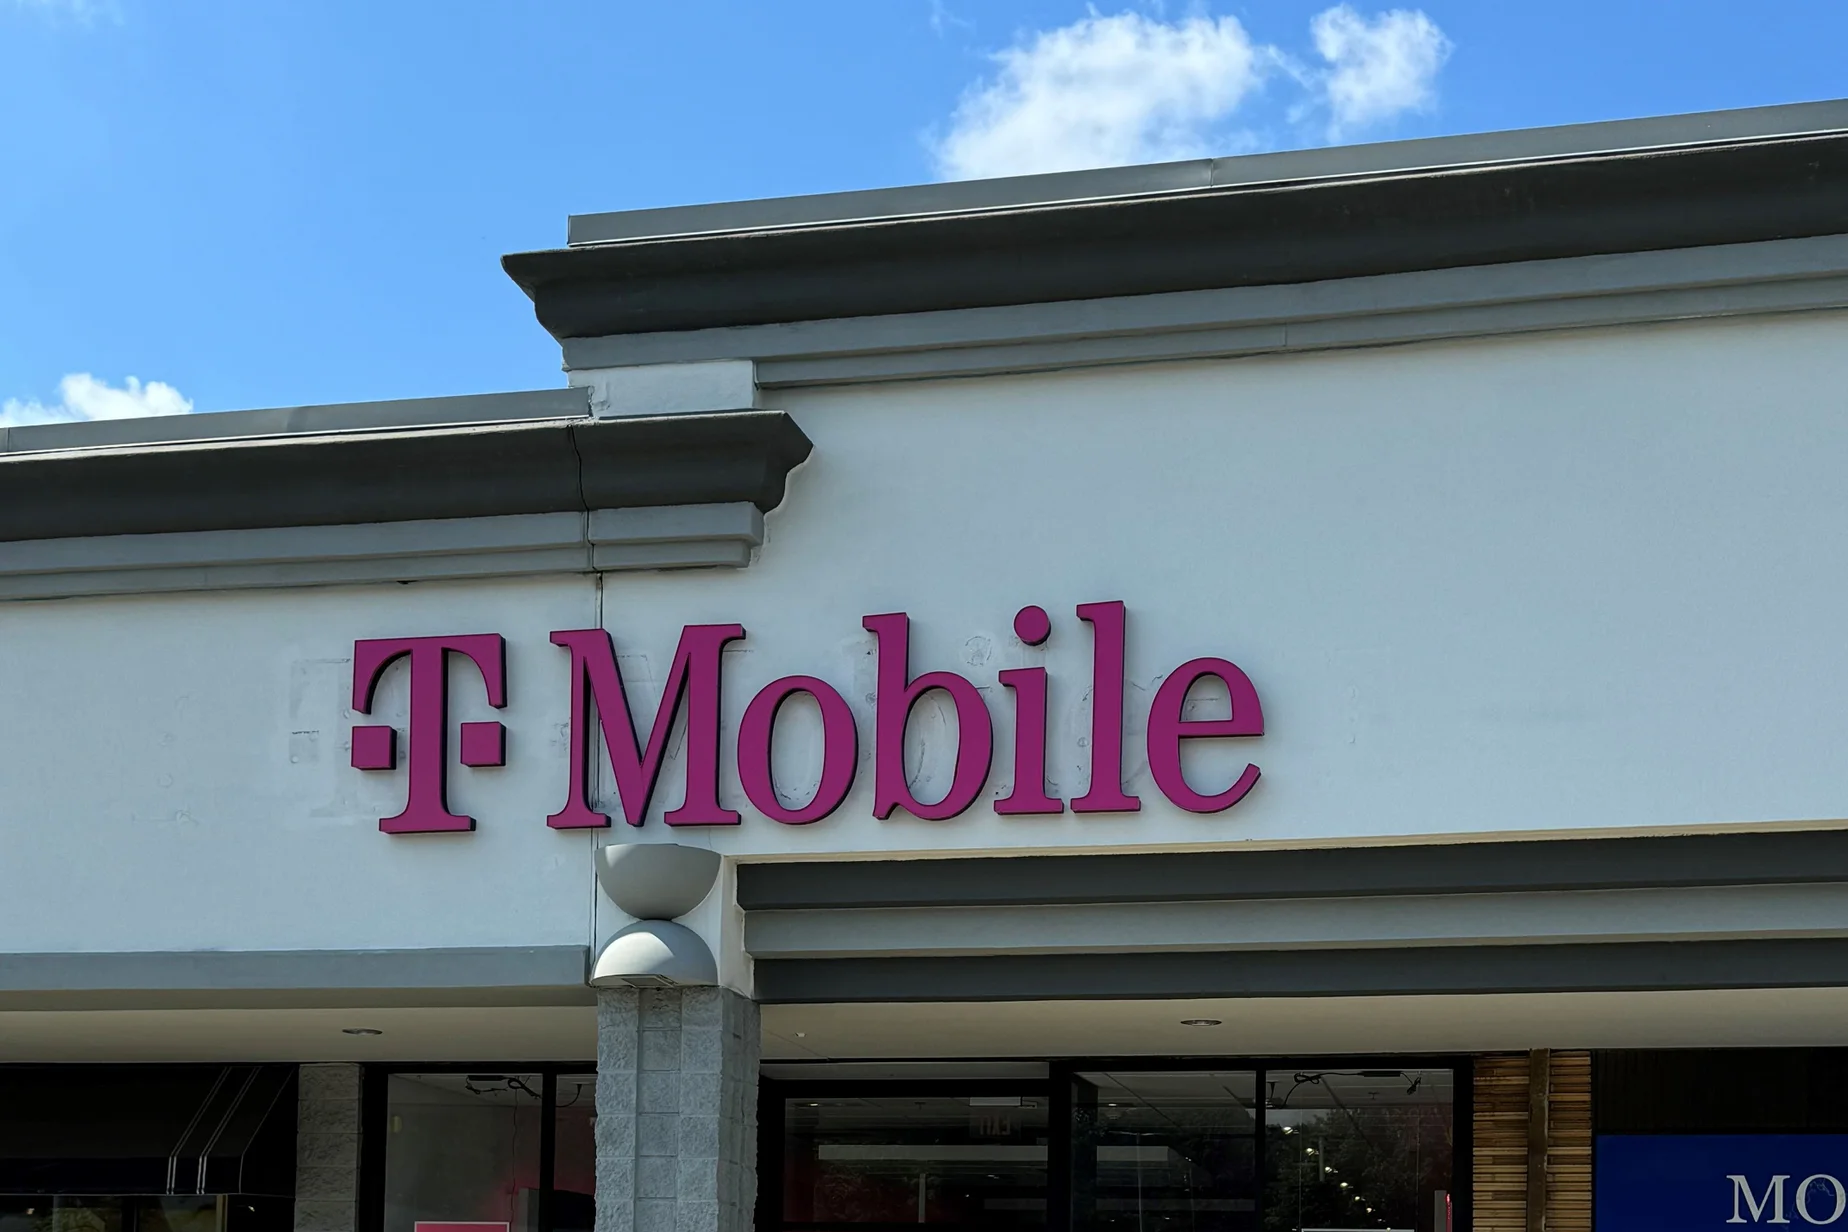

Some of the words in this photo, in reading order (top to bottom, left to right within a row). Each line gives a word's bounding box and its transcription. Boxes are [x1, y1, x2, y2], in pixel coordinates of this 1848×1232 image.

[352, 632, 508, 834] T
[546, 600, 1266, 827] Mobile
[1726, 1173, 1847, 1225] MO
